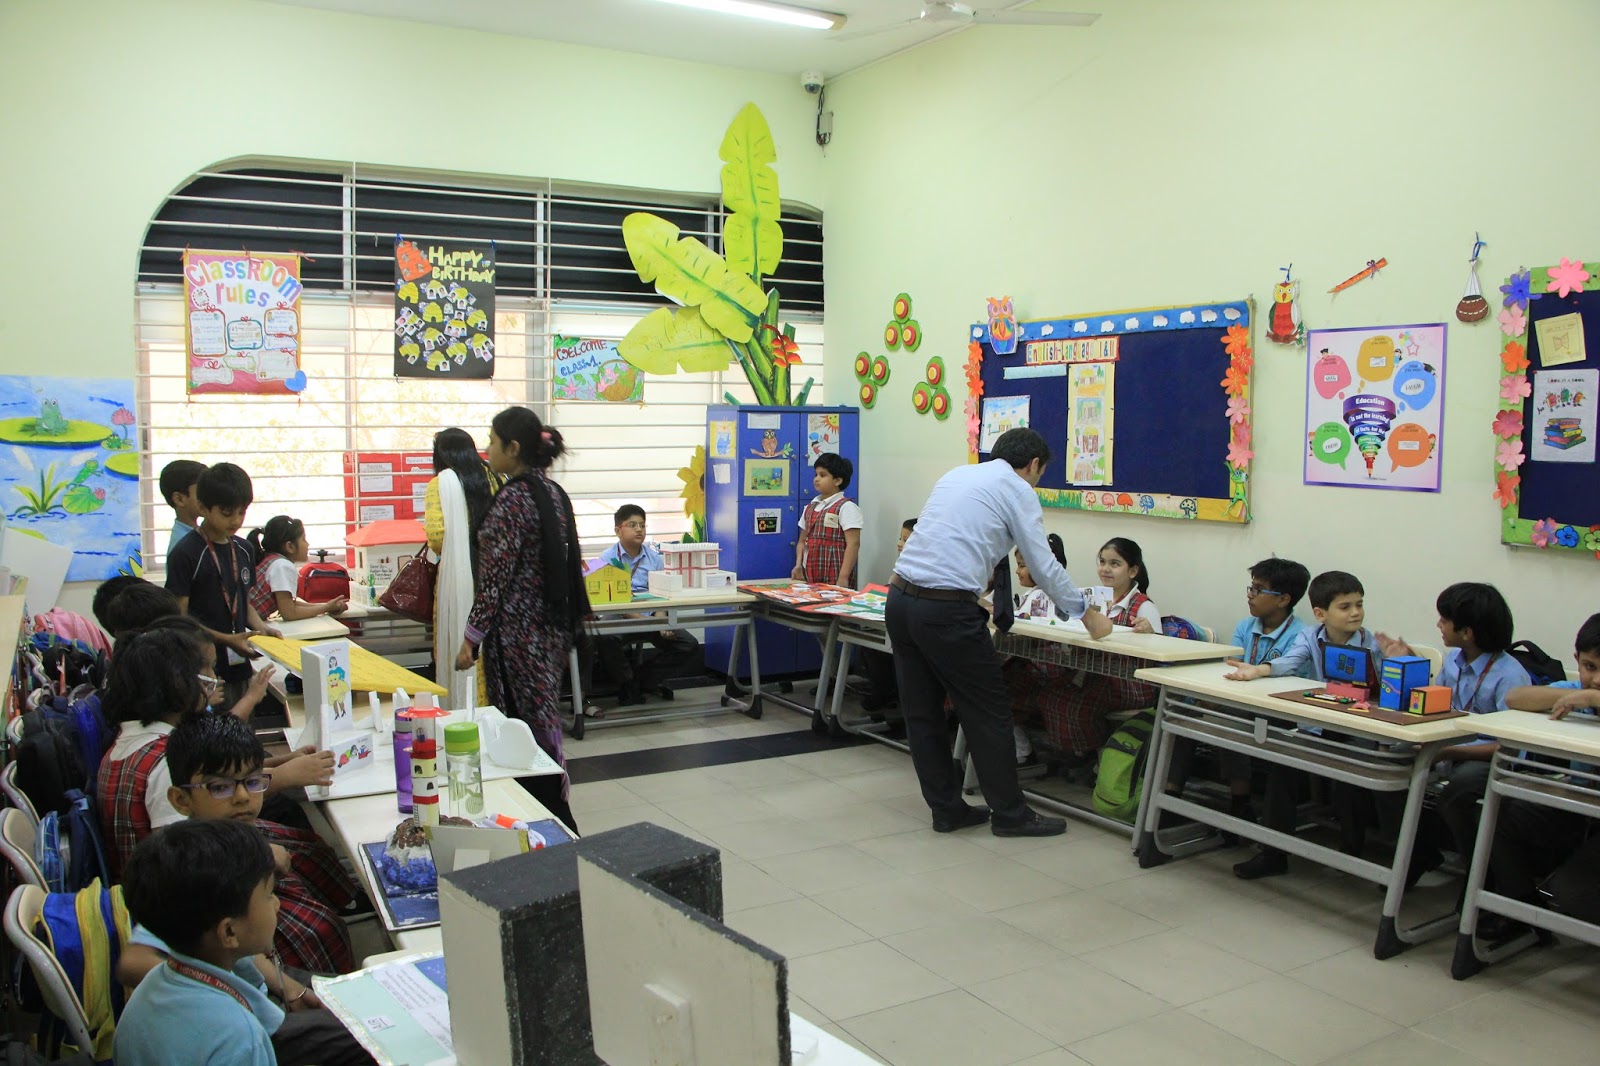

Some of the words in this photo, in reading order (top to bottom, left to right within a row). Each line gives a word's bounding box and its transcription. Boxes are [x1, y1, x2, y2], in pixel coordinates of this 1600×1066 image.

[428, 245, 484, 268] HAPPY
[216, 281, 270, 307] rules
[556, 340, 607, 361] WELCOME
[1372, 412, 1390, 423] learning
